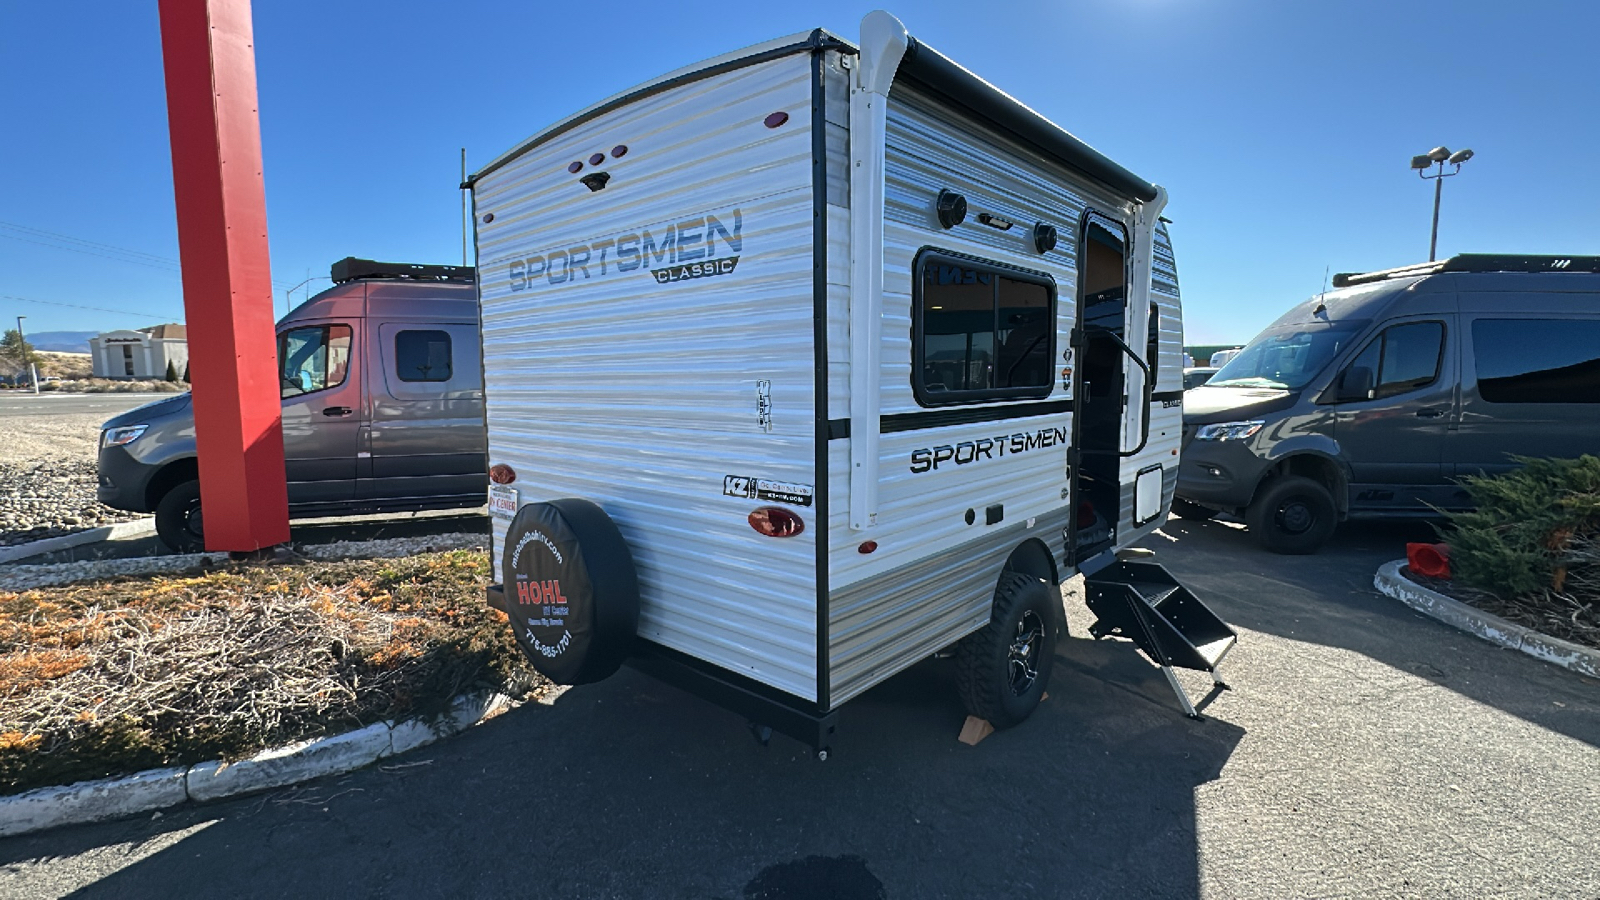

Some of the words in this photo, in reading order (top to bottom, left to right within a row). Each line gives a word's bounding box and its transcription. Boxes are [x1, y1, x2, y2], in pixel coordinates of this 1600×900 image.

[509, 208, 743, 292] SPORTSMEN
[657, 261, 733, 283] CLASSIC
[910, 426, 1067, 474] SPORTSMEN
[516, 580, 568, 605] HOHL
